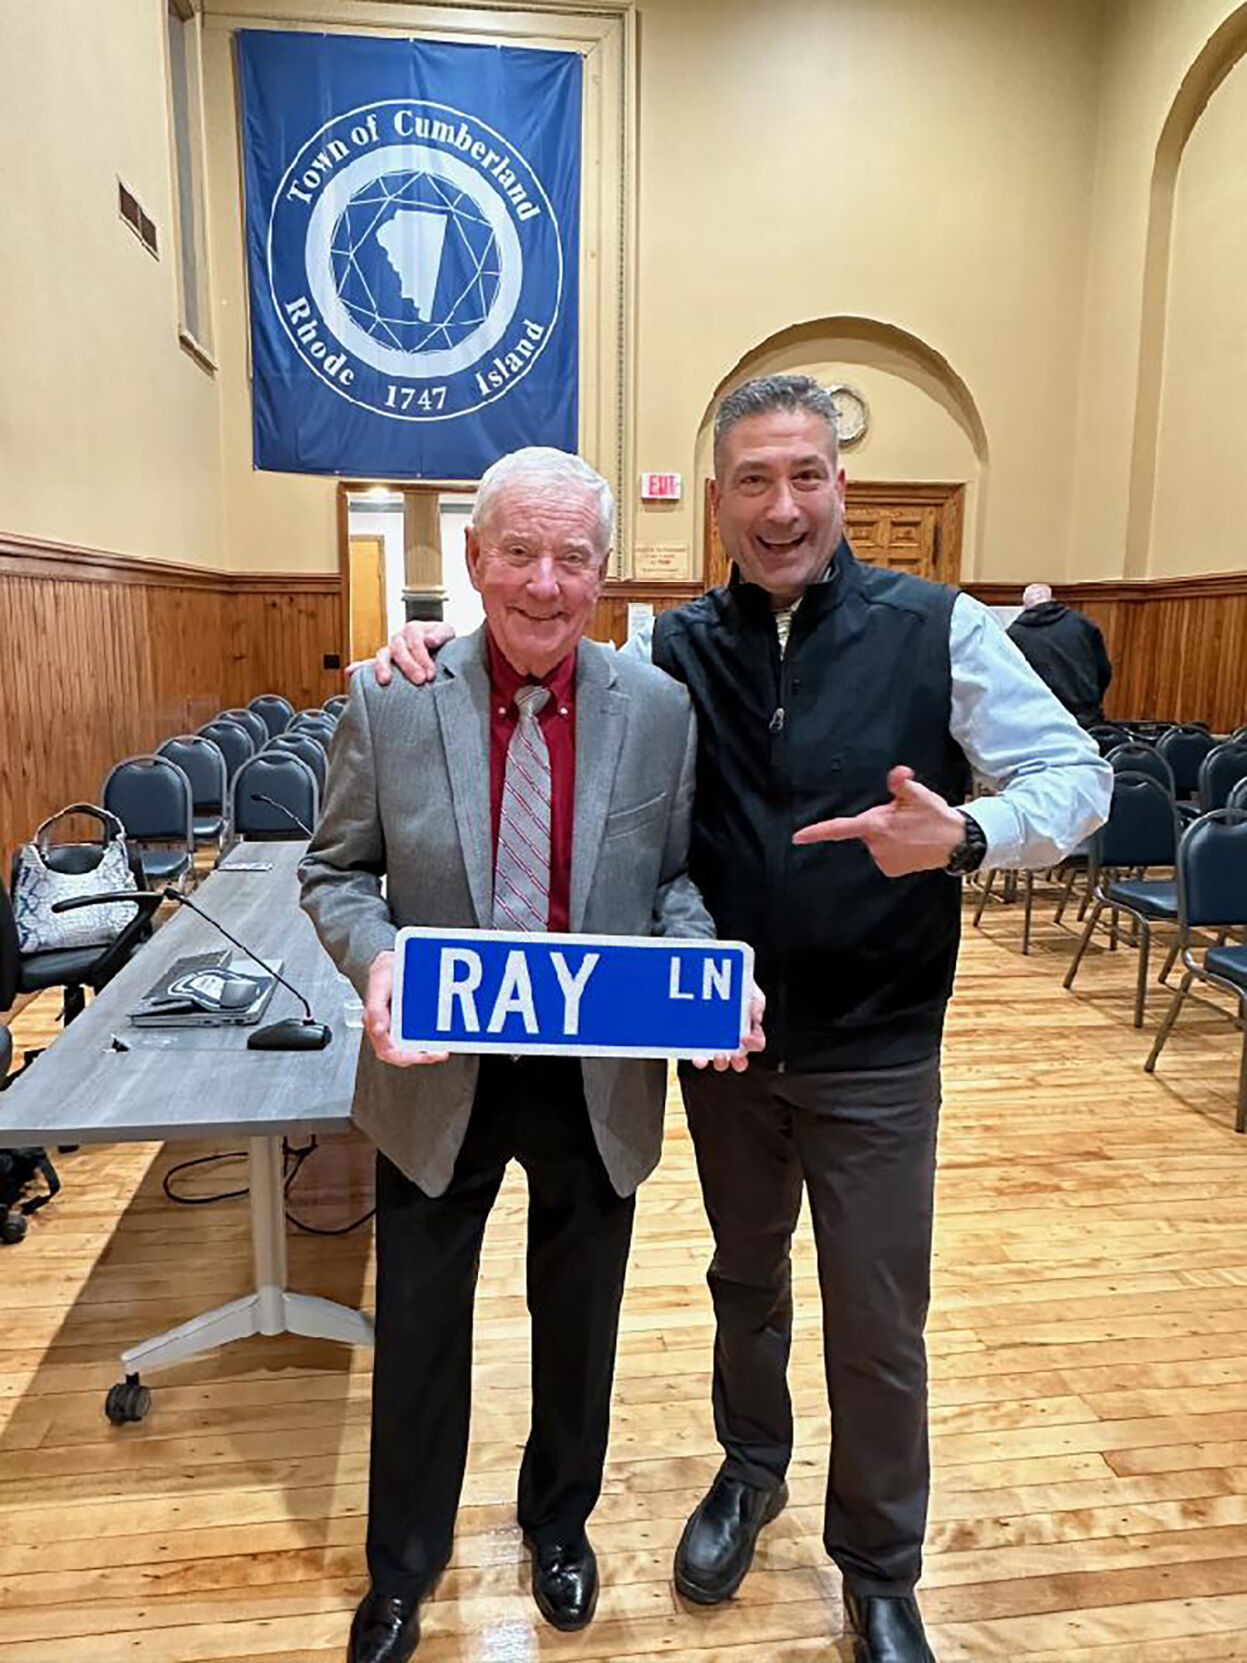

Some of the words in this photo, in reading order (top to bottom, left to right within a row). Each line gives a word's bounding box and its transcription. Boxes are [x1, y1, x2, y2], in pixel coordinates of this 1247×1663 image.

[287, 139, 350, 204] Town
[351, 114, 380, 146] of
[393, 110, 542, 222] Cumberland
[285, 296, 355, 386] Rhode
[384, 385, 448, 411] 1747
[474, 318, 546, 397] Island
[648, 474, 677, 496] EXIT
[436, 946, 600, 1036] RAY
[669, 956, 732, 1000] LN
